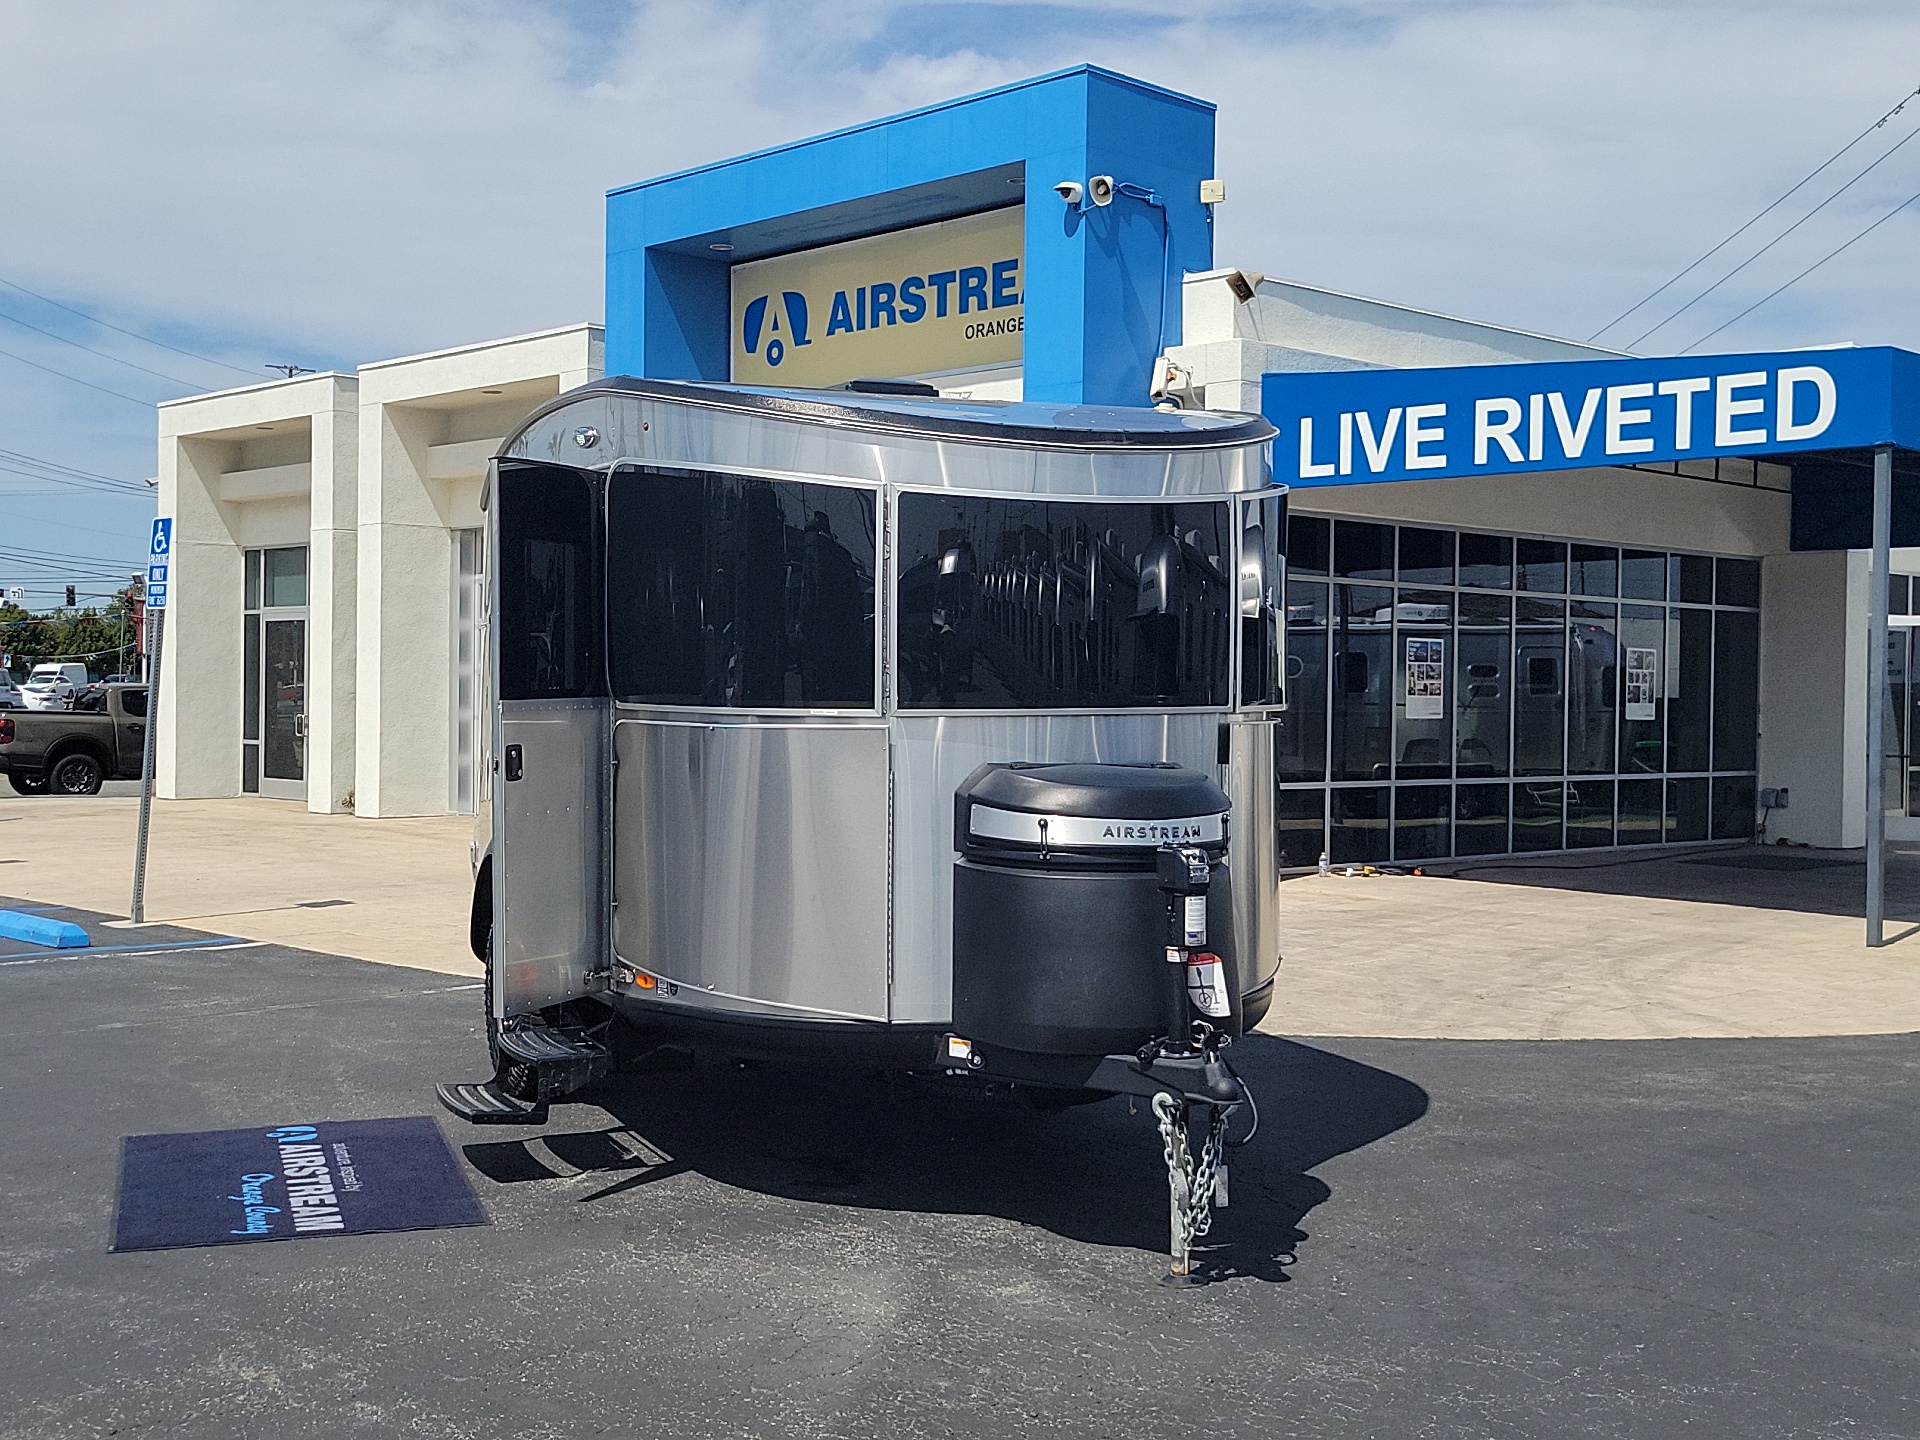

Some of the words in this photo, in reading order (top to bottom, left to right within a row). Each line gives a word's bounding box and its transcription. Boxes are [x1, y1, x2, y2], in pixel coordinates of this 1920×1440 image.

[826, 258, 1025, 337] AIRSTRE
[965, 316, 1025, 340] ORANGE
[1299, 402, 1447, 478] LIVE
[1474, 365, 1837, 465] RIVETED
[1102, 824, 1201, 840] AIRSTREAM
[228, 1173, 275, 1205] Orange
[279, 1144, 345, 1231] AIRSTREAM
[229, 1206, 281, 1234] County
